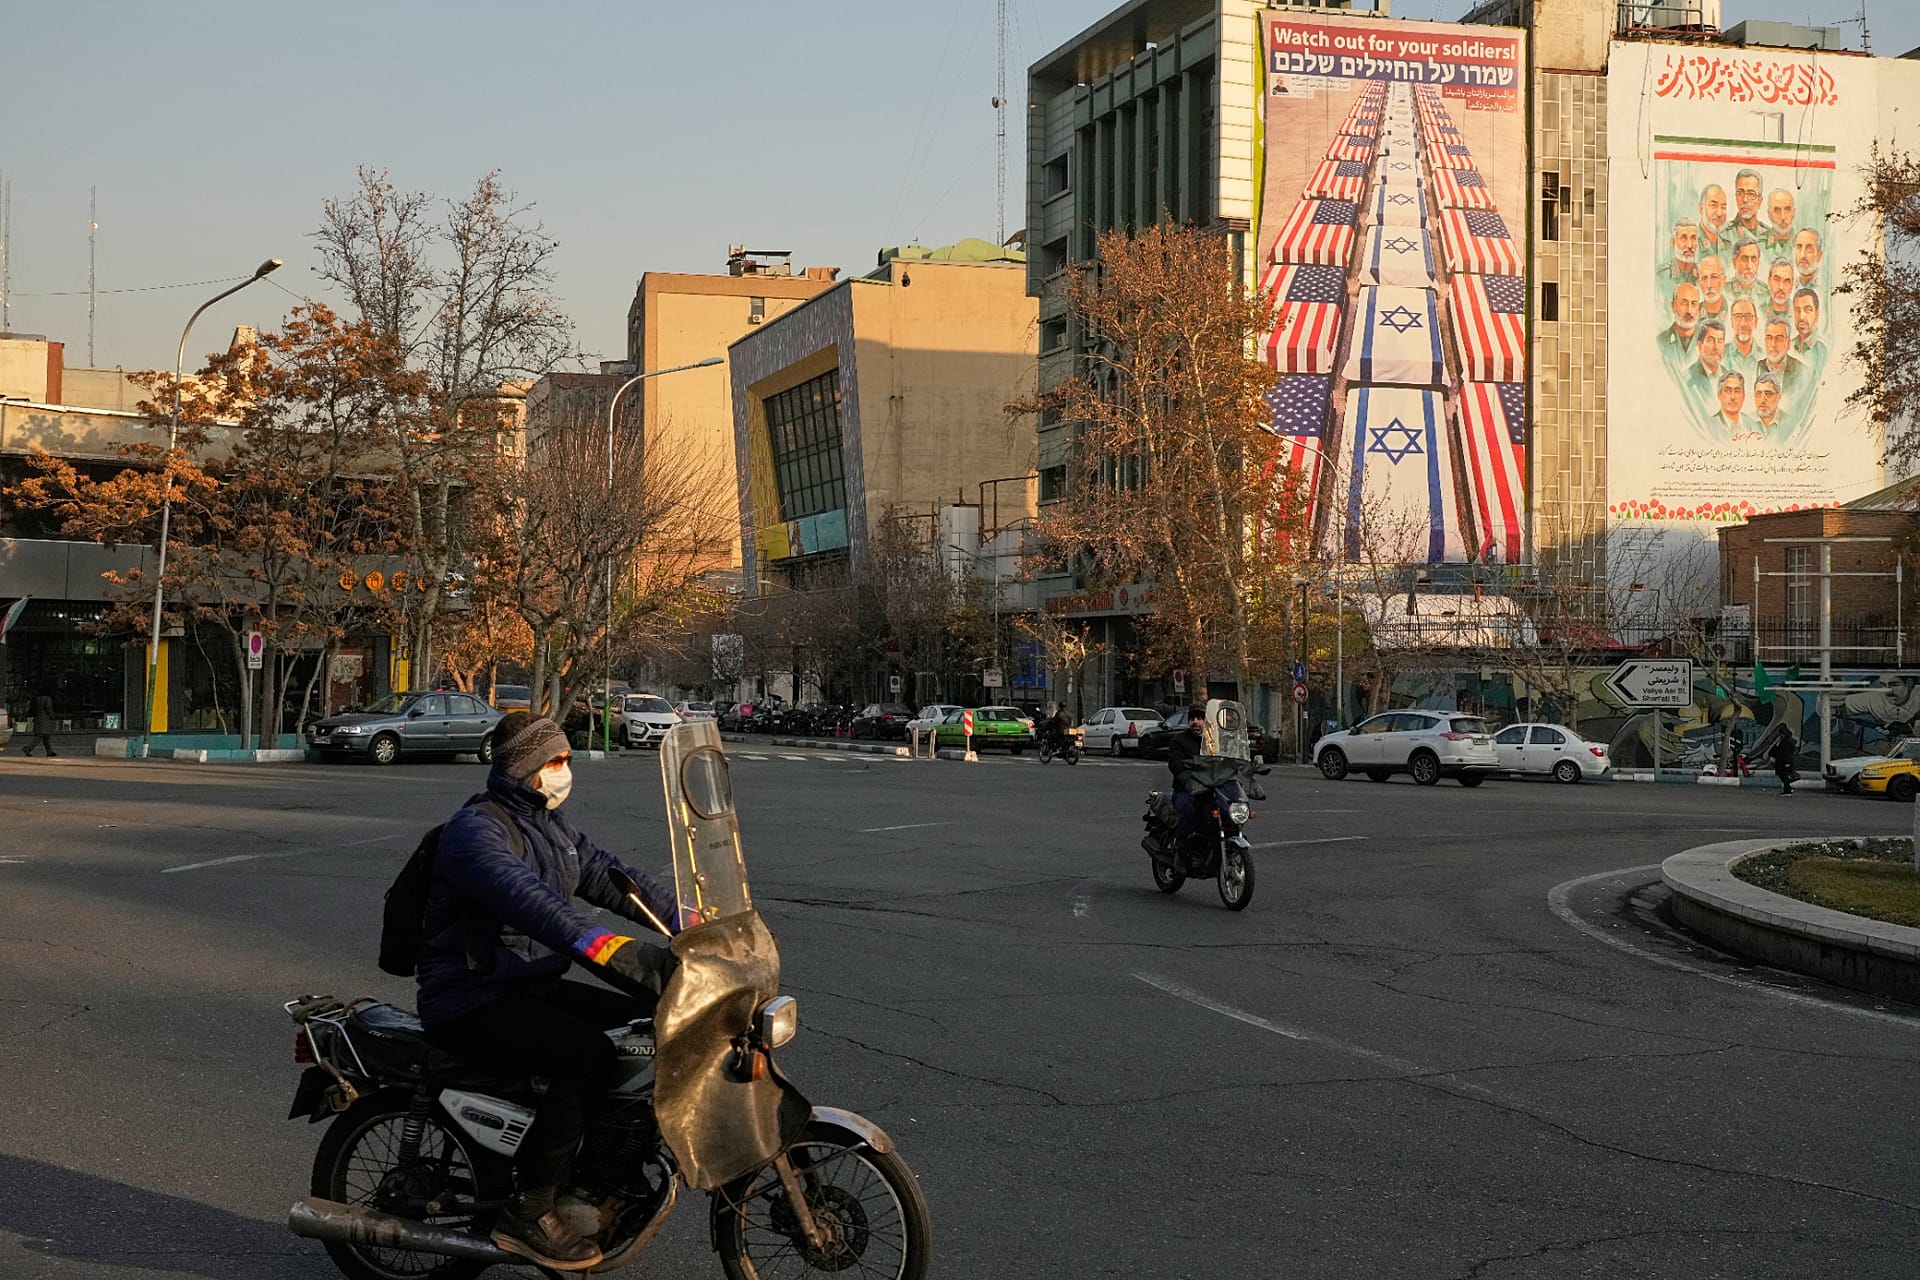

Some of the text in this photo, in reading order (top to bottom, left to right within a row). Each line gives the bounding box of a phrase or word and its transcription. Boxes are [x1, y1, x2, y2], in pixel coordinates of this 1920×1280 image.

[1274, 27, 1516, 60] Watch out for your soldiers!
[1274, 48, 1514, 86] שמרו על החיילים שלכם
[1649, 664, 1679, 674] ولیعصر
[1648, 675, 1679, 686] شریعتی
